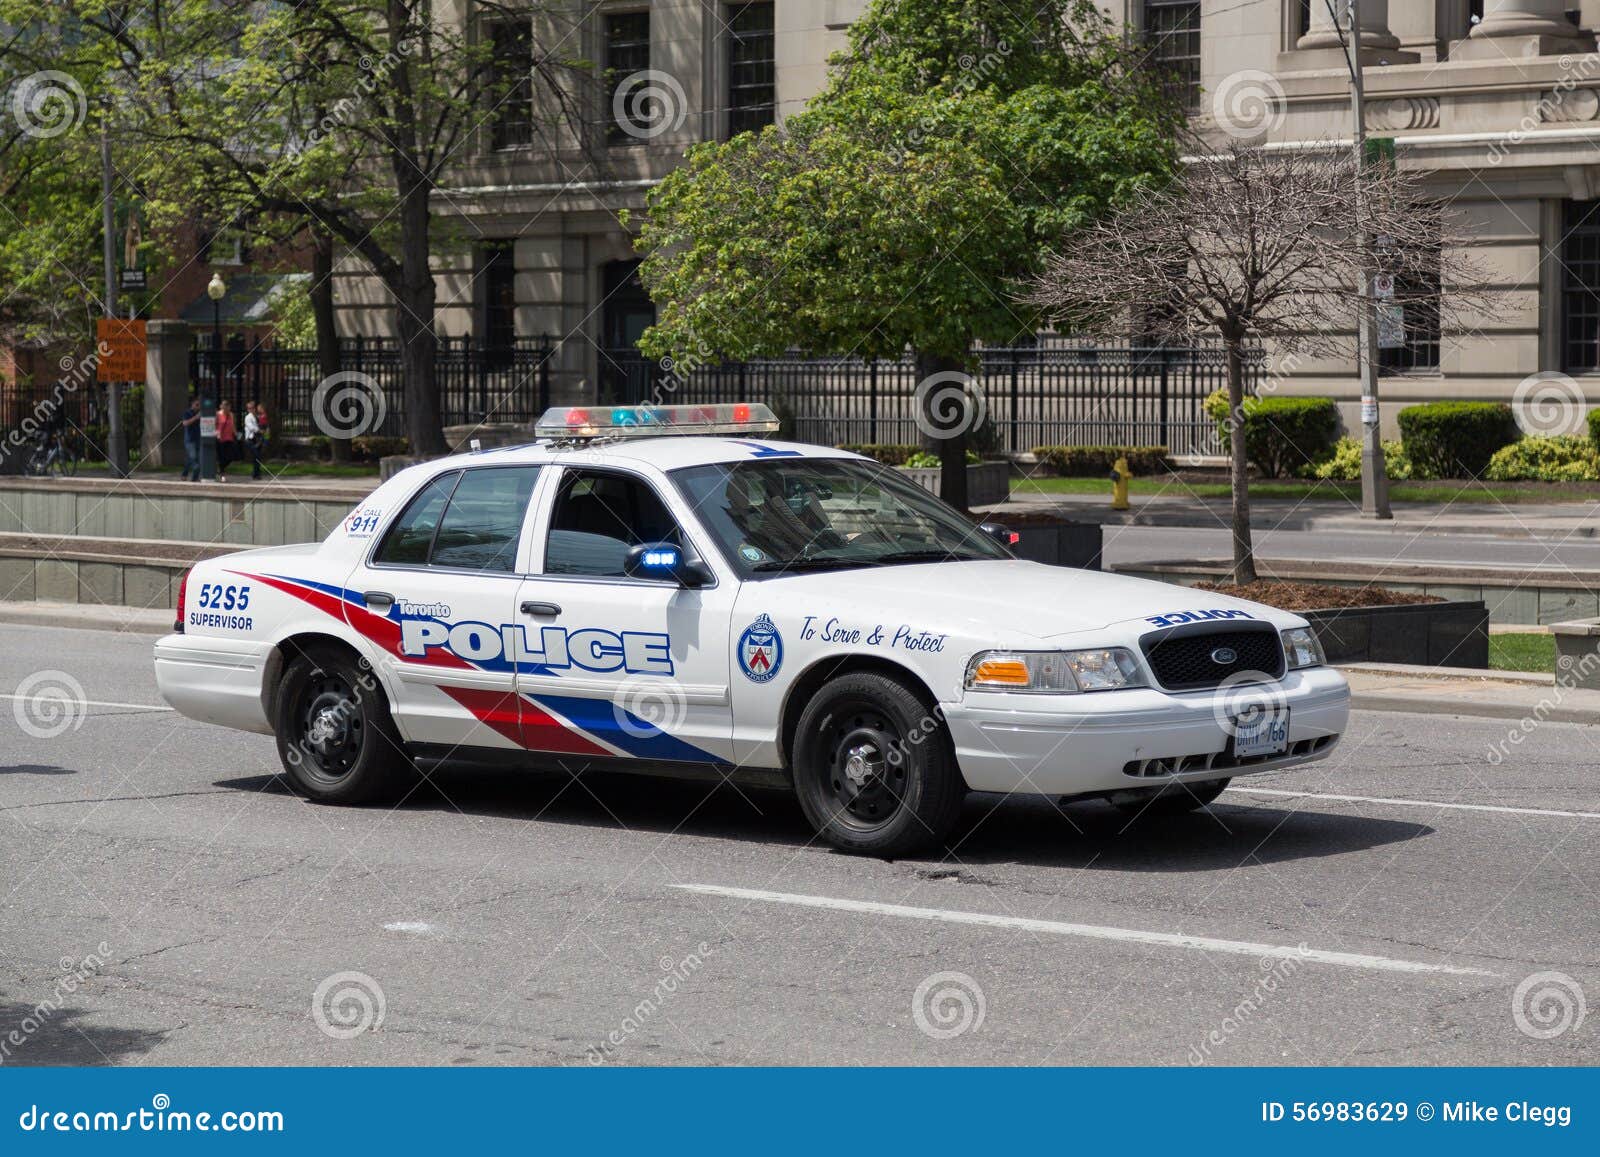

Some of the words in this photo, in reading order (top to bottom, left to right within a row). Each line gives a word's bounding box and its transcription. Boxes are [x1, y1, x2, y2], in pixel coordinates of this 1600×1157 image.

[199, 584, 250, 611] 52S5
[398, 599, 451, 617] Toronto
[190, 612, 253, 630] SUPERVISOR
[800, 616, 817, 641] To
[821, 617, 860, 644] Serve
[867, 624, 885, 646] &
[891, 624, 950, 653] Protect
[400, 619, 674, 676] POLICE
